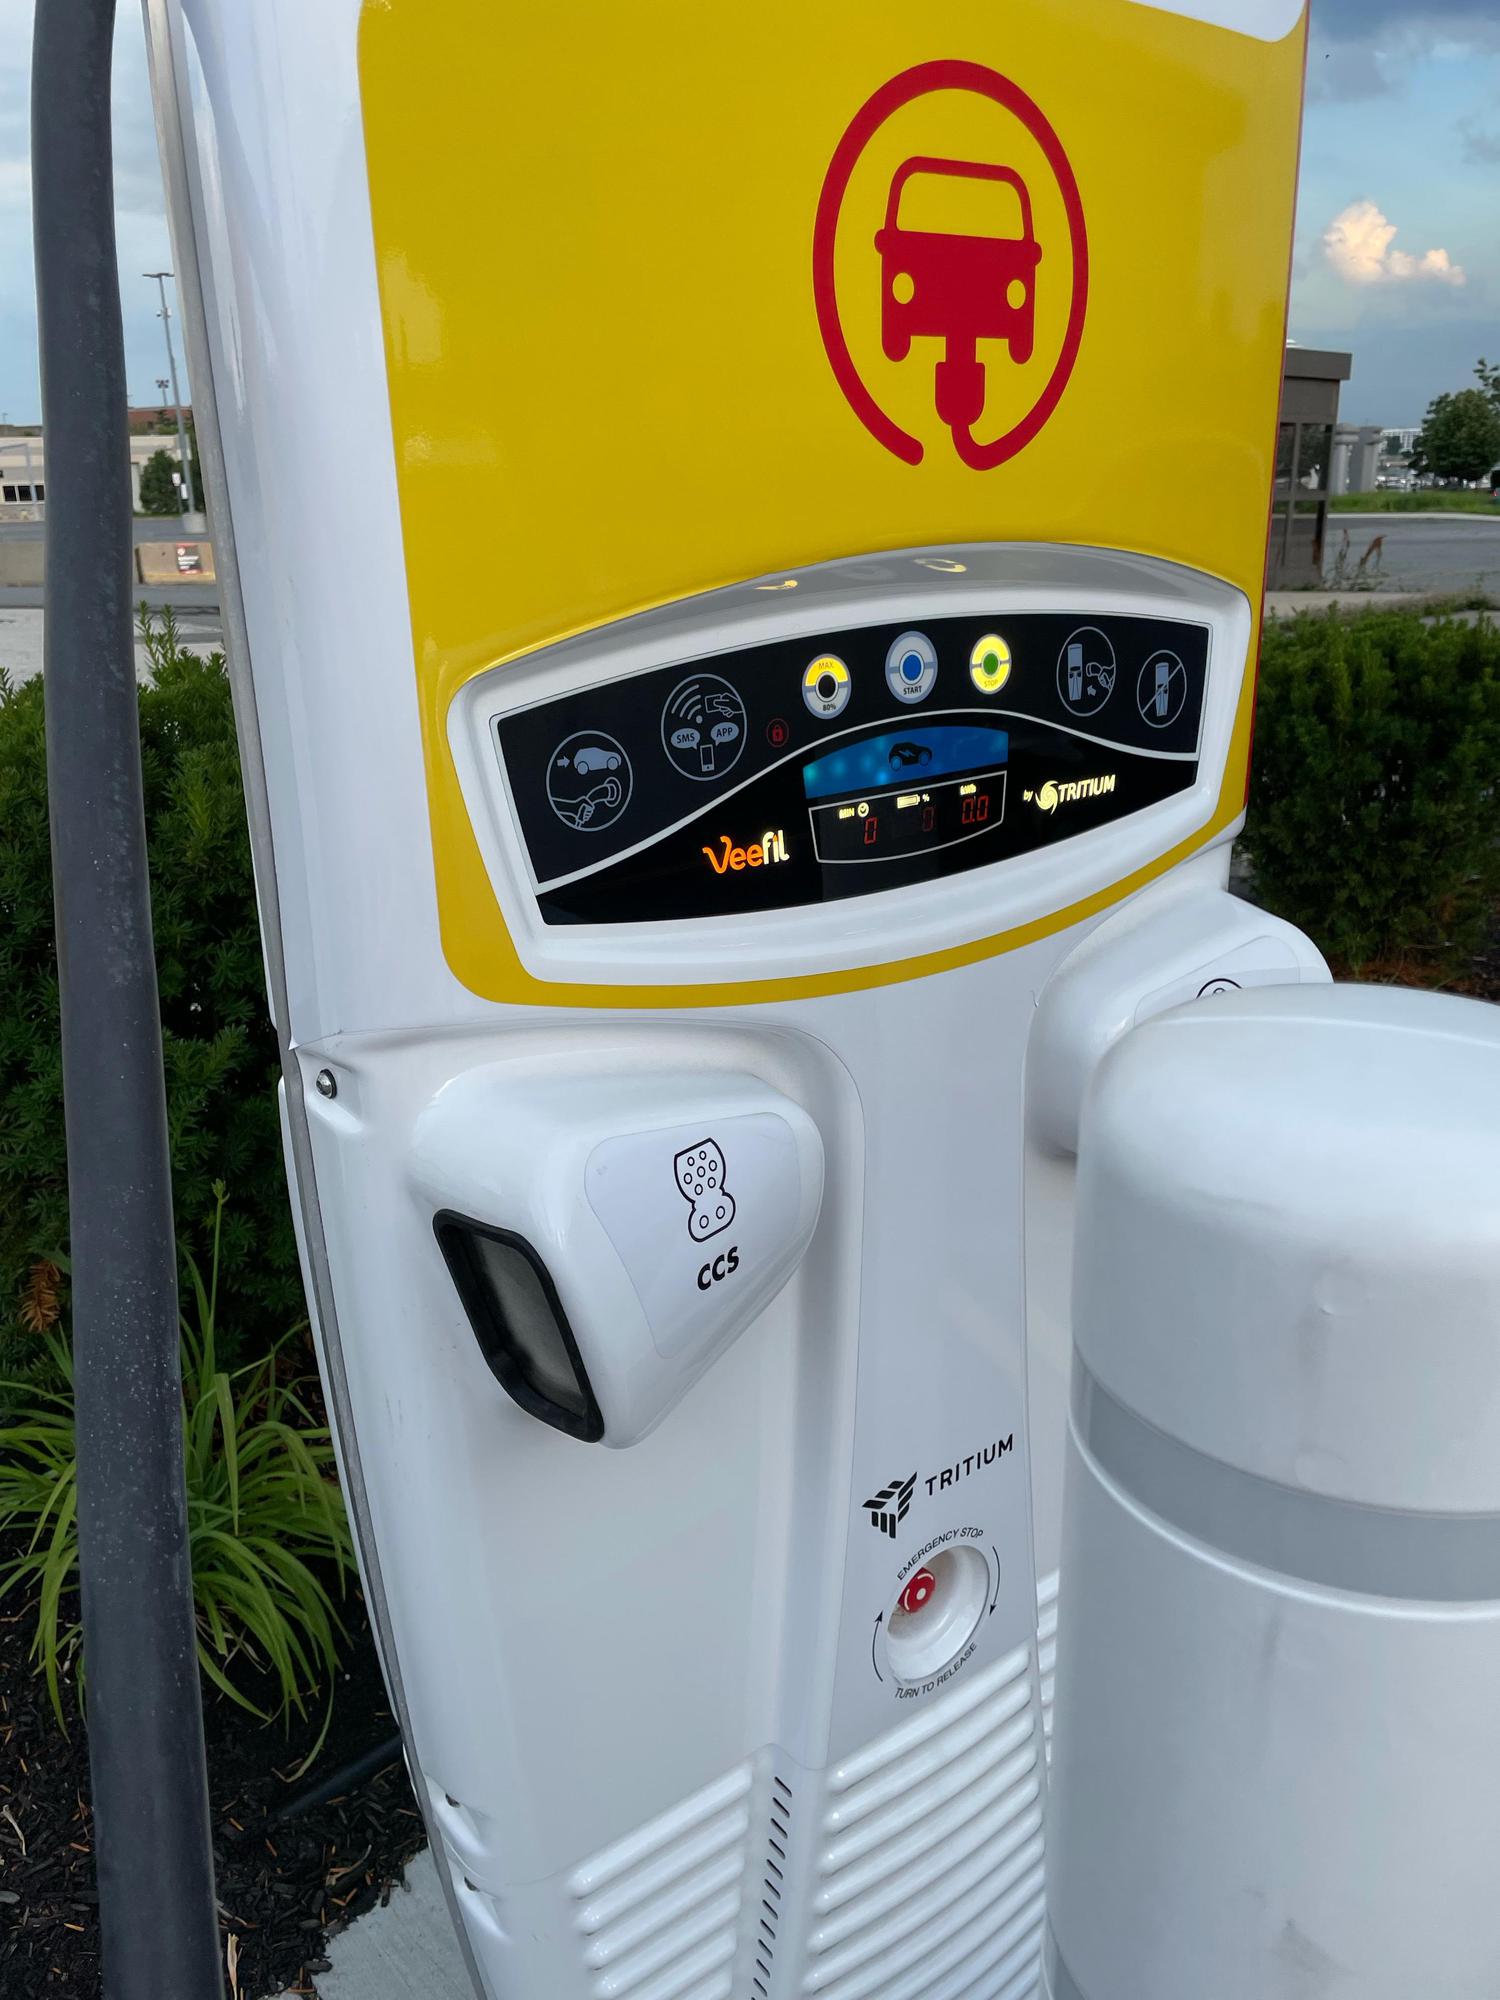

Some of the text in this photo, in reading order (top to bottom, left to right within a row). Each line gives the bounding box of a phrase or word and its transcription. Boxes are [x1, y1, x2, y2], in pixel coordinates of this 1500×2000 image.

[819, 661, 834, 669] MAX
[903, 686, 922, 695] START
[984, 679, 999, 688] STOP
[822, 703, 837, 711] 80%
[675, 732, 696, 744] SMS
[715, 726, 733, 739] APP
[1023, 774, 1116, 803] by TRITIUM
[838, 807, 855, 819] MIN
[864, 816, 878, 845] 0
[703, 830, 790, 874] Veefil
[697, 1246, 739, 1291] CCS
[925, 1433, 1014, 1496] TRITIUM
[897, 1527, 984, 1580] EMERGENCY STOP
[895, 1642, 977, 1699] TURN TO RELEASE
